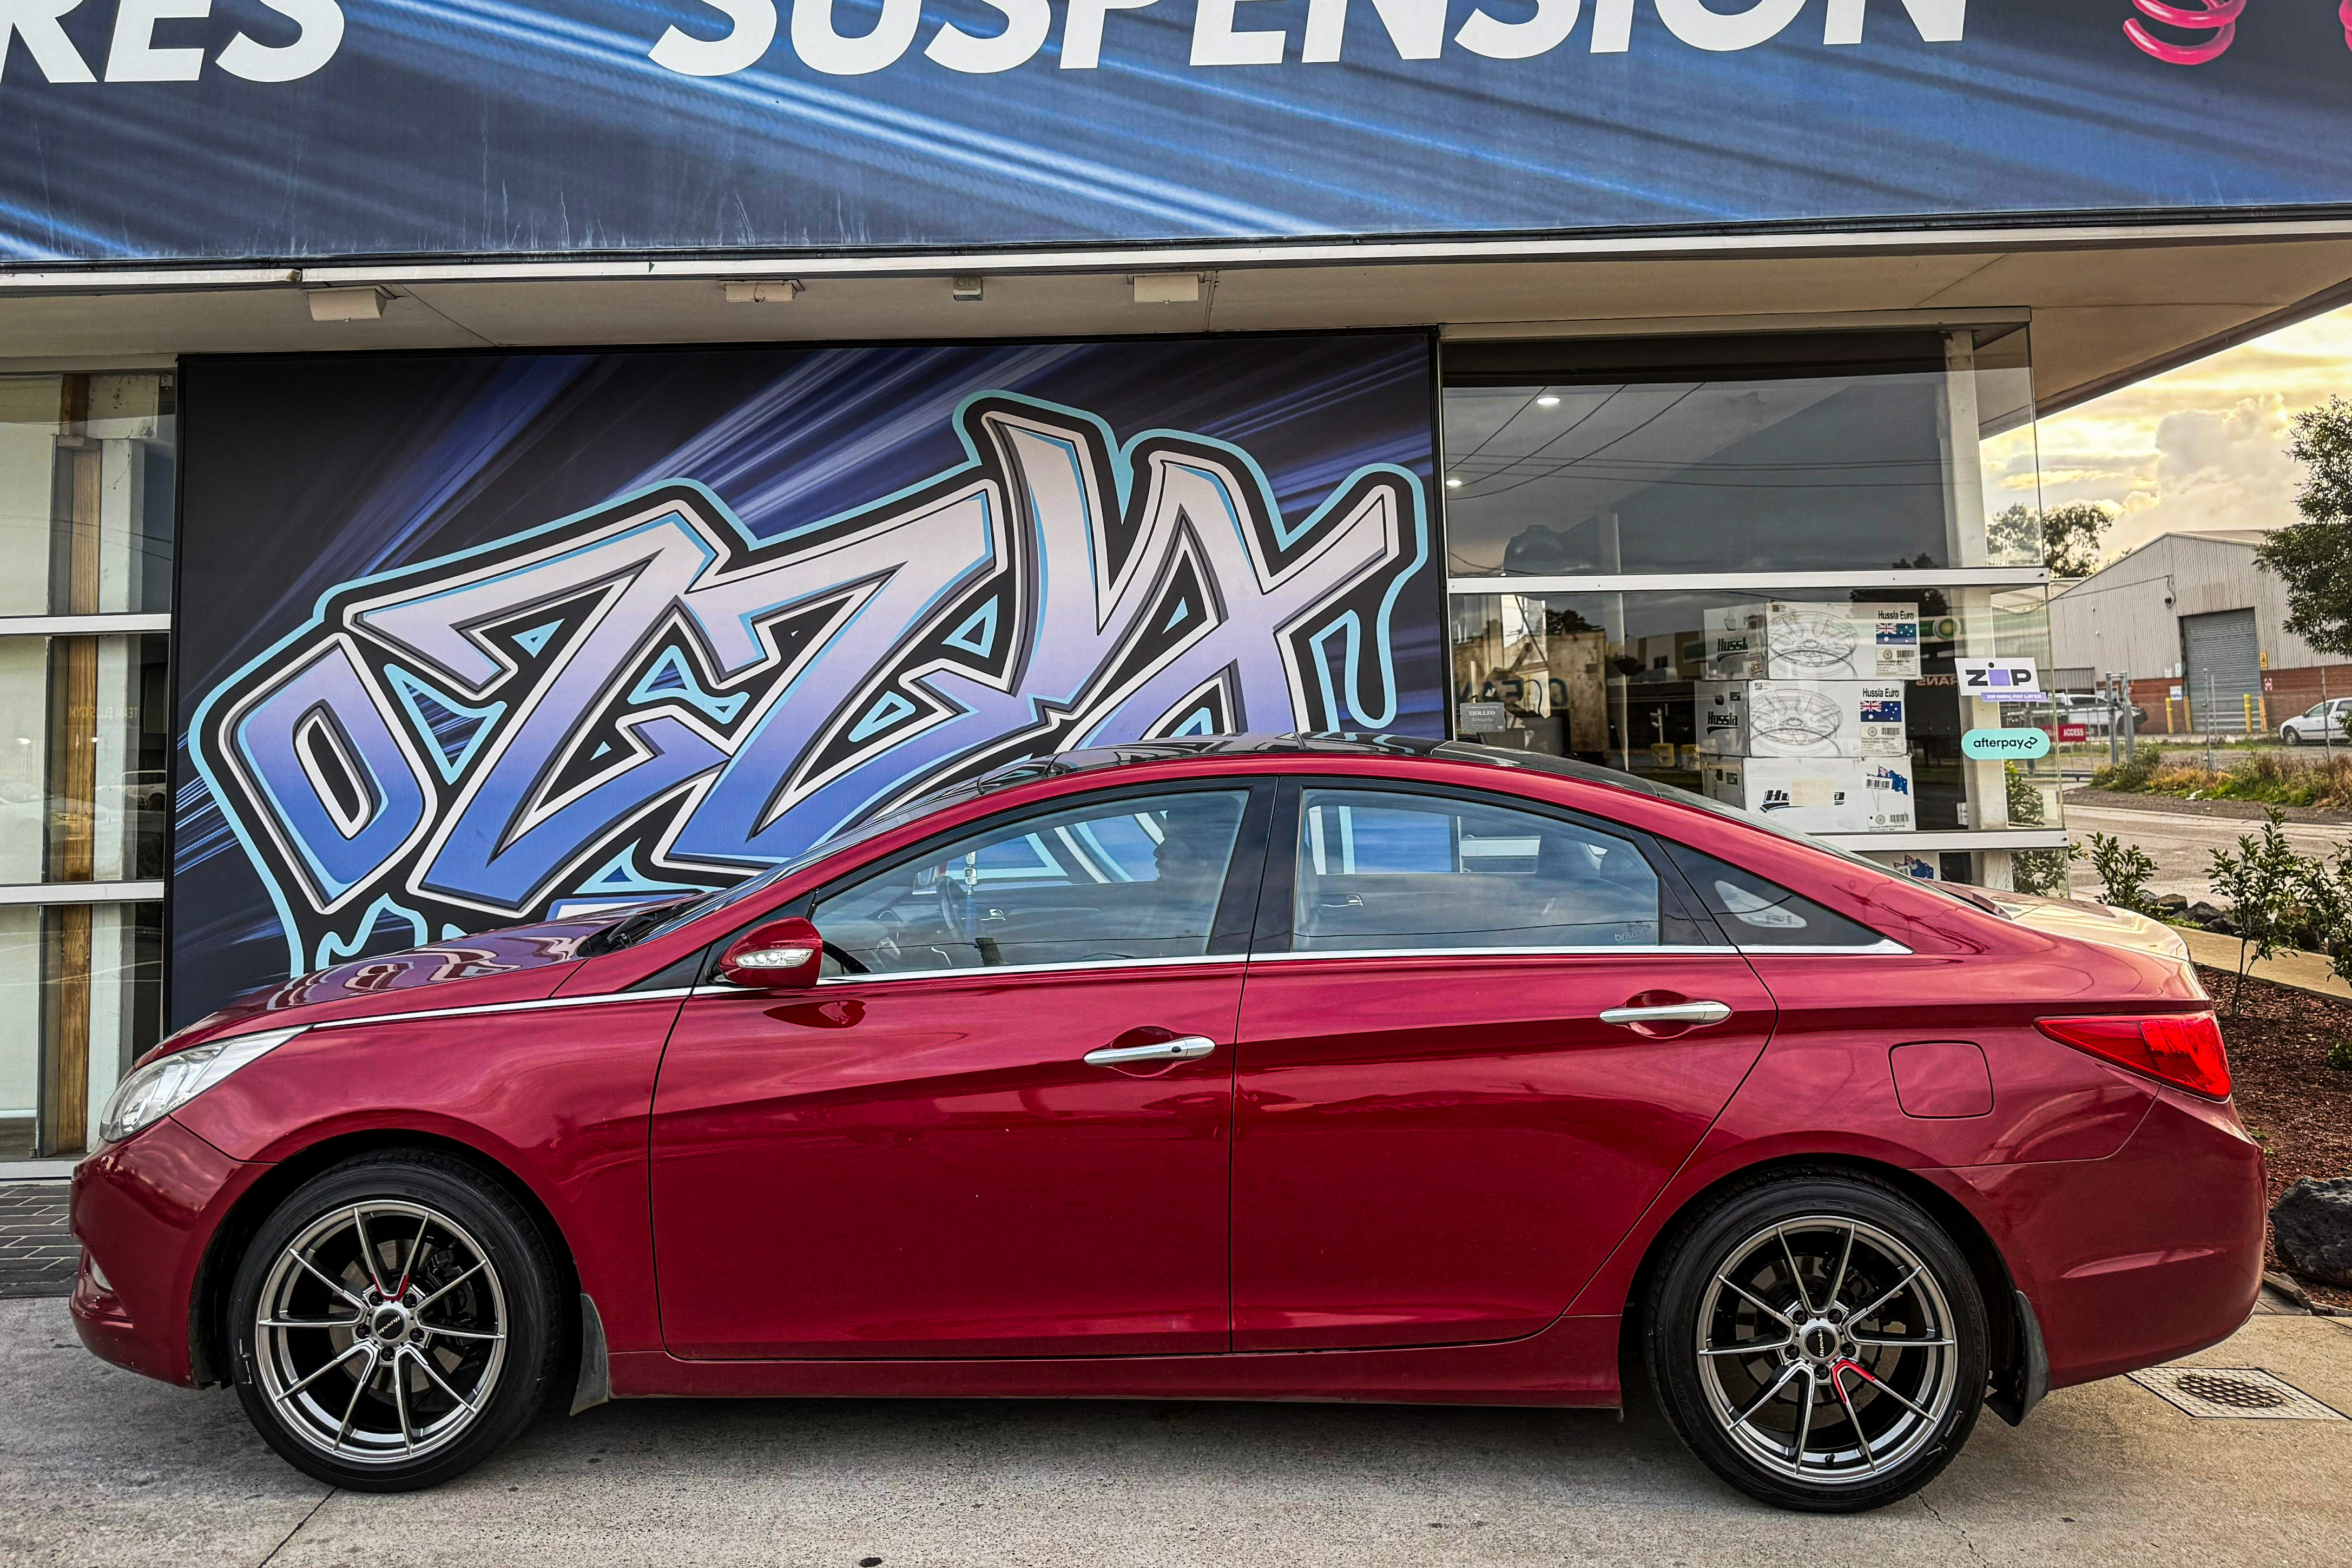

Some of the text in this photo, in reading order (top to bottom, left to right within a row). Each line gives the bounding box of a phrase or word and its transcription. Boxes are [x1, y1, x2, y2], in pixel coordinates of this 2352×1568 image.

[1900, 611, 1914, 620] Euro
[1717, 637, 1748, 651] Hussl
[1885, 688, 1899, 697] Euro
[2063, 728, 2084, 736] ACCESS
[1974, 737, 2024, 749] afterpay
[1764, 789, 1845, 803] Hua
